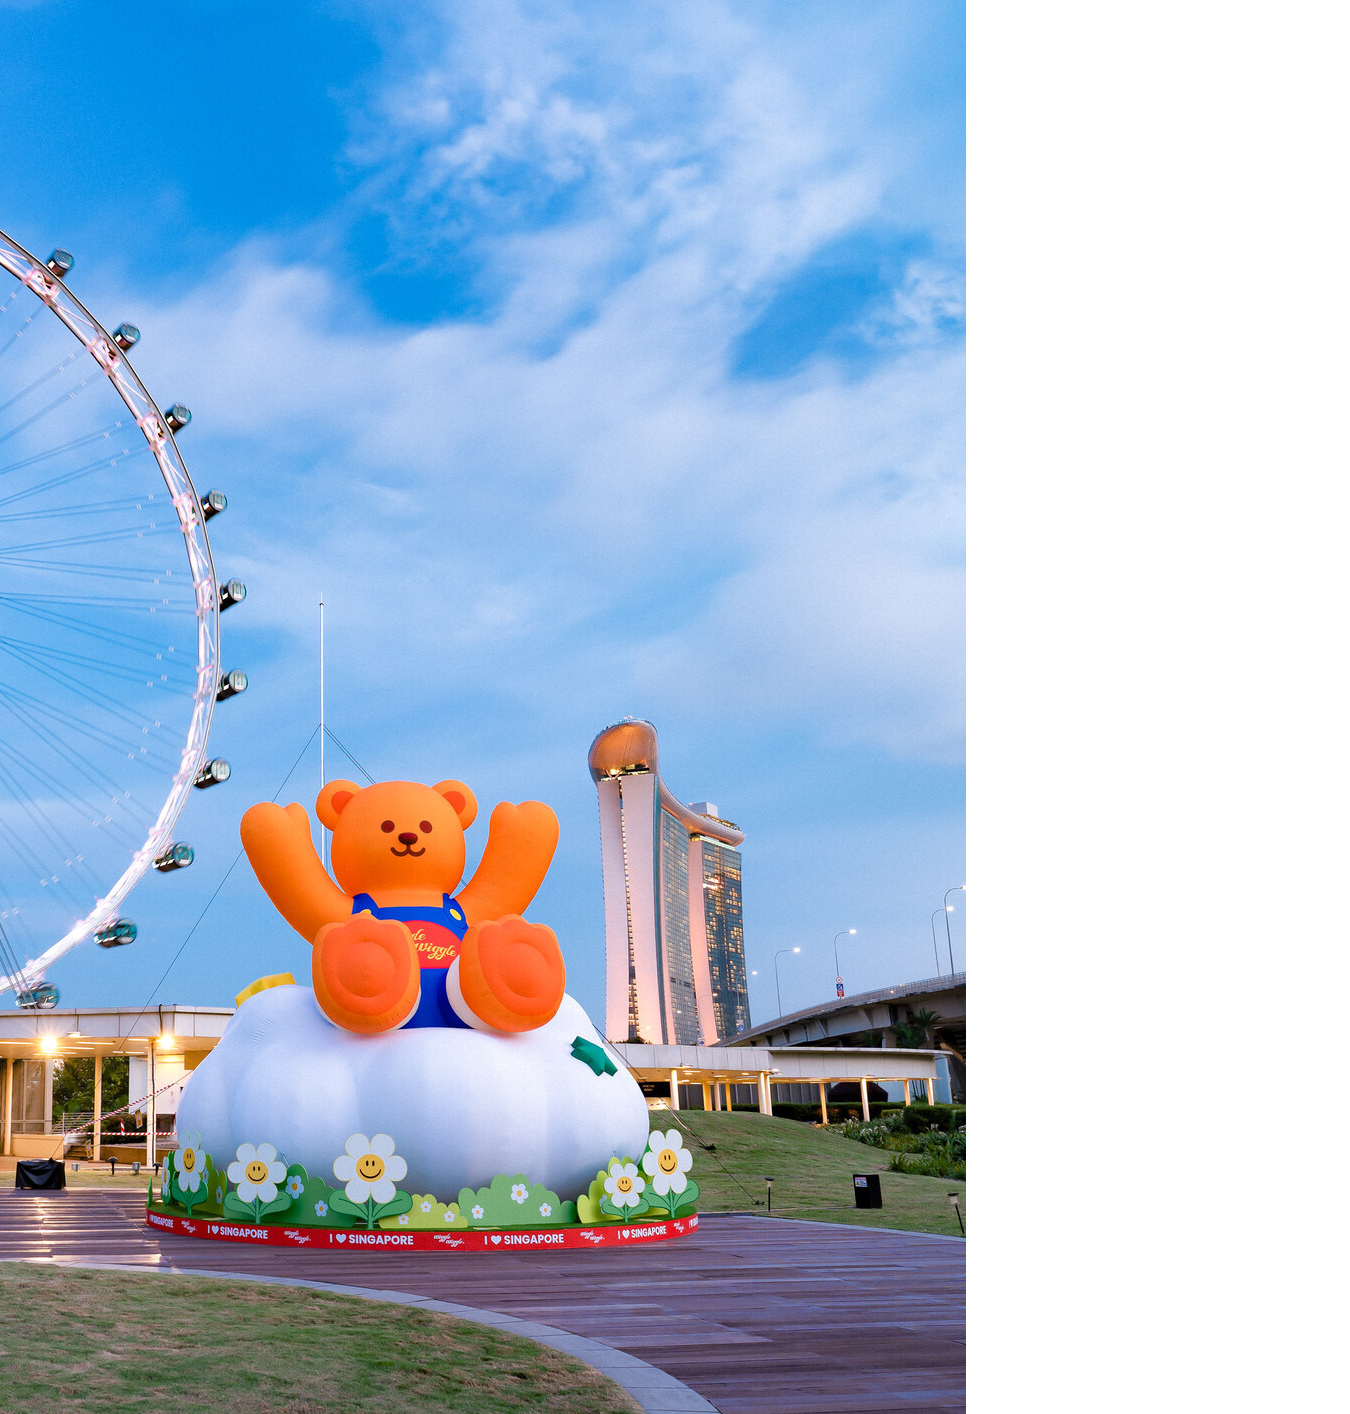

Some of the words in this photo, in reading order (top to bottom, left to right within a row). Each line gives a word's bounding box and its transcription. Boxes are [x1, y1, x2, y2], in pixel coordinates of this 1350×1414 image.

[220, 1226, 268, 1239] SINGAPORE
[631, 1226, 666, 1238] SINGAPORE
[349, 1234, 414, 1245] SINGAPORE
[504, 1234, 564, 1245] SINGAPORE
